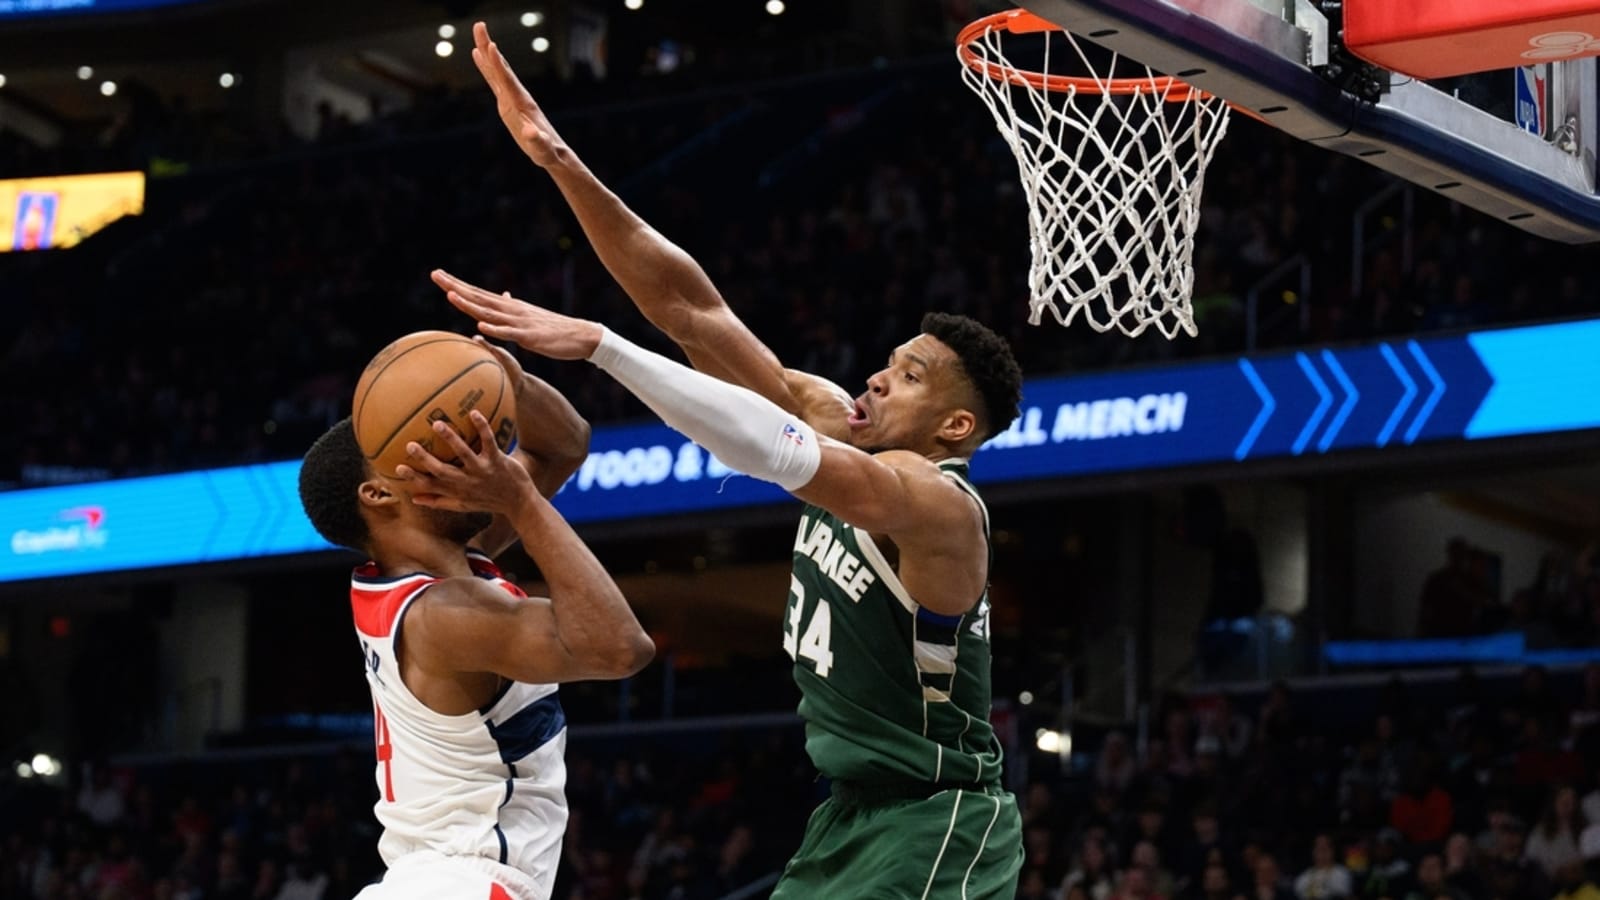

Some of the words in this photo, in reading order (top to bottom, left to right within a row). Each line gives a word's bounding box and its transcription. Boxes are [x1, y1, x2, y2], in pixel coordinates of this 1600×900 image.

[577, 445, 673, 491] FOOD
[1052, 391, 1188, 443] MERCH
[783, 573, 833, 678] 34
